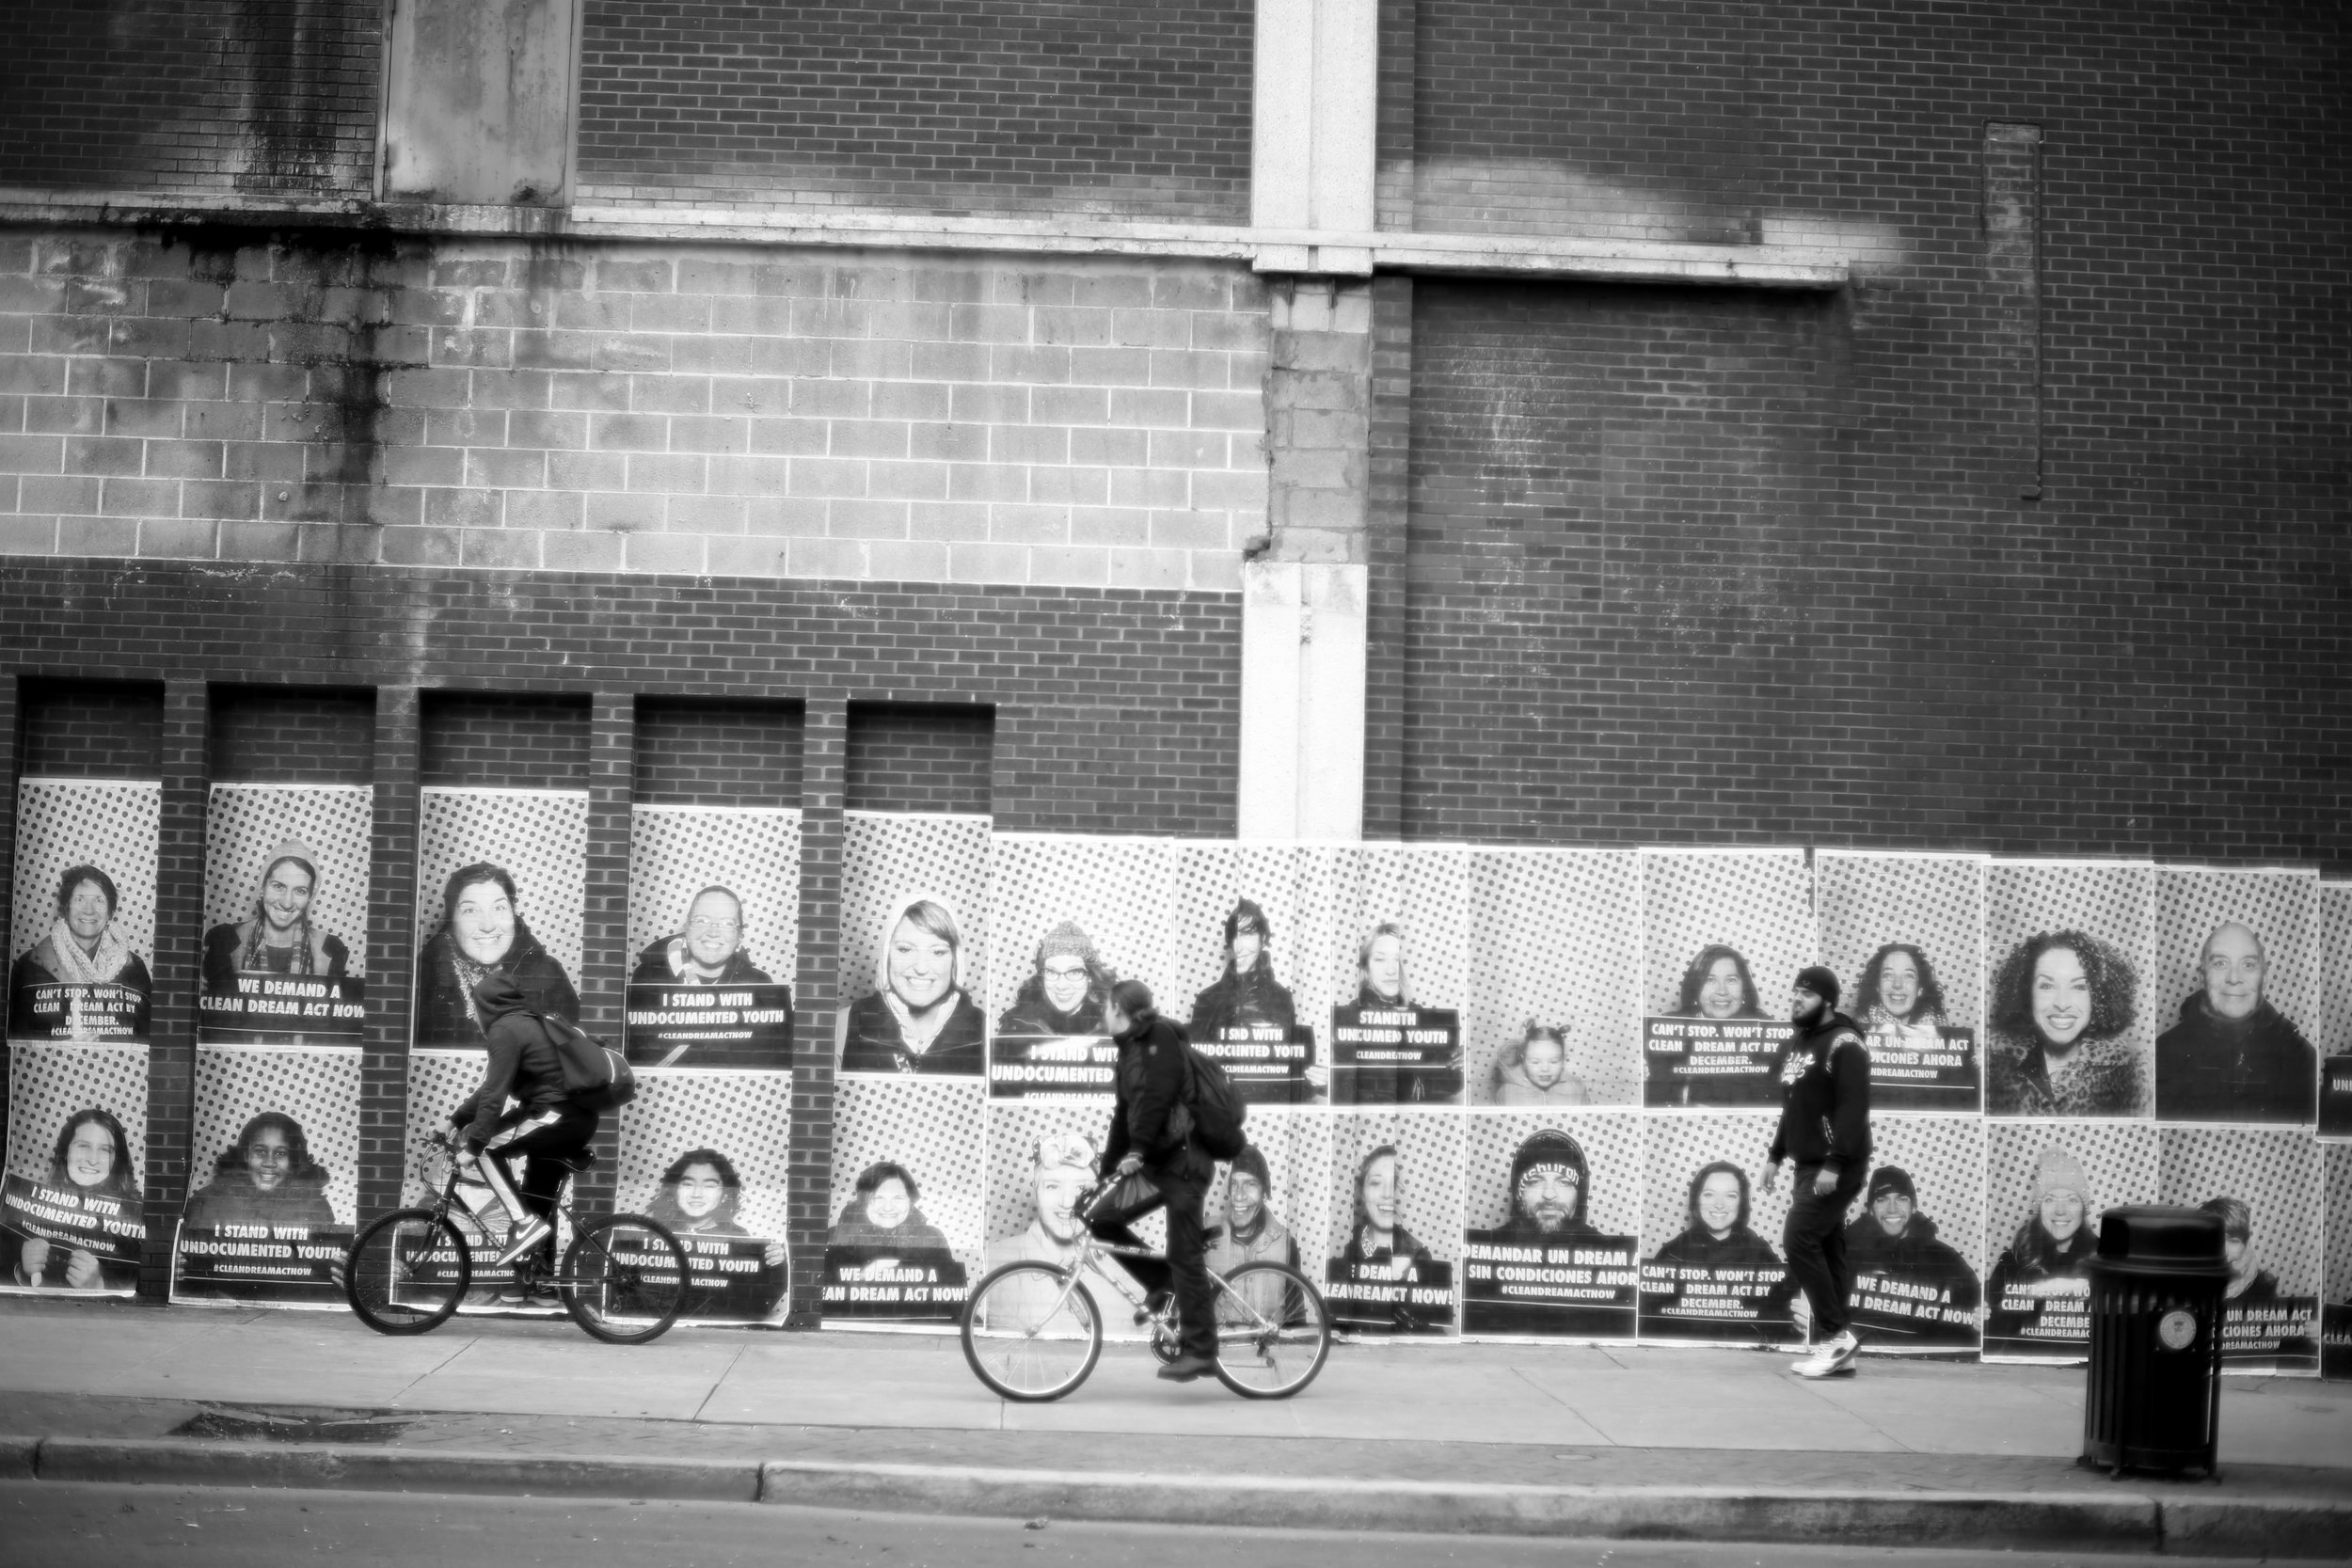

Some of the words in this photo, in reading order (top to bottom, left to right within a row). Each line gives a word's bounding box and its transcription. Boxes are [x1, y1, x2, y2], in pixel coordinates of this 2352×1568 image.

[36, 989, 61, 999] CAN'T
[65, 989, 90, 998] STOP.
[238, 978, 260, 993] WE
[264, 981, 326, 997] DEMAND
[330, 986, 340, 998] A
[199, 996, 243, 1011] CLEAN
[248, 999, 298, 1015] DREAM
[303, 1003, 329, 1016] ACT
[663, 993, 667, 1006] I
[673, 993, 714, 1006] STAND
[720, 993, 753, 1006] WITH
[34, 1003, 59, 1013] CLEAN
[107, 1003, 123, 1011] ACT
[126, 1004, 135, 1013] BY
[66, 1016, 119, 1025] DCEMBER.
[628, 1011, 738, 1024] UNDOCUMENTED
[742, 1010, 784, 1023] YOUTH
[659, 1031, 753, 1039] #CLEANDREAMACTNOW
[1220, 1028, 1225, 1040] I
[1252, 1029, 1282, 1040] WITH
[1406, 1030, 1448, 1043] YOUTH
[1652, 1023, 1684, 1036] CAN'T
[1688, 1026, 1719, 1037] STOP.
[1723, 1026, 1763, 1037] WON'T
[1766, 1028, 1794, 1038] STOP
[1649, 1039, 1682, 1052] CLEAN
[1695, 1041, 1736, 1052] DREAM
[1740, 1042, 1760, 1052] ACT
[1763, 1043, 1779, 1053] BY
[1885, 1037, 1900, 1047] UN
[1949, 1039, 1969, 1051] ACT
[1031, 1046, 1035, 1059] I
[1691, 1056, 1752, 1066] DECEMBER.
[1923, 1054, 1963, 1066] AHORA
[992, 1065, 1114, 1082] UNDOCUMENTED
[31, 1186, 38, 1197] I
[39, 1189, 79, 1207] STAND
[84, 1198, 120, 1215] WITH
[6, 1194, 98, 1228] UNDOCUMENTED
[103, 1219, 146, 1239] YOUTH
[22, 1221, 115, 1252] #CLEANDREAMACTNOW
[215, 1225, 219, 1237] I
[225, 1226, 268, 1239] STAND
[274, 1227, 309, 1240] WITH
[180, 1241, 292, 1258] UNDOCUMENTED
[297, 1246, 341, 1259] YOUTH
[644, 1238, 648, 1249] I
[697, 1242, 729, 1255] WITH
[1463, 1244, 1542, 1262] DEMANDAR
[1548, 1249, 1568, 1263] UN
[1574, 1251, 1627, 1265] DREAM
[214, 1264, 311, 1275] #CLEANDREAMACTNOW
[719, 1259, 759, 1272] YOUTH
[840, 1268, 861, 1281] WE
[865, 1268, 924, 1282] DEMAND
[928, 1269, 937, 1282] A
[1407, 1268, 1418, 1282] A
[1469, 1265, 1491, 1279] SIN
[1497, 1267, 1592, 1284] CONDICIONES
[1643, 1266, 1676, 1278] CAN'T
[1680, 1268, 1711, 1280] STOP.
[1716, 1270, 1755, 1281] WON'T
[1757, 1271, 1786, 1281] STOP
[850, 1288, 899, 1301] DREAM
[904, 1288, 929, 1301] ACT
[933, 1288, 969, 1301] NOW!
[1502, 1286, 1615, 1299] #CLEANDREAMACTNOW
[1640, 1281, 1674, 1293] CLEAN
[1687, 1284, 1727, 1295] DREAM
[1731, 1286, 1752, 1295] ACT
[1756, 1286, 1771, 1296] BY
[1857, 1275, 1877, 1291] WE
[1881, 1280, 1938, 1301] DEMAND
[1942, 1290, 1950, 1304] A
[1412, 1289, 1453, 1305] NOW!
[1681, 1298, 1743, 1309] DECEMBER.
[1661, 1307, 1757, 1318] #CLEANDREAMACTNOW
[1864, 1296, 1912, 1316] DREAM
[1915, 1305, 1940, 1320] ACT
[2002, 1299, 2034, 1310] CLEAN
[2046, 1301, 2084, 1312] DREAM
[2041, 1316, 2090, 1328] DECEMBE
[2227, 1310, 2243, 1321] UN
[2247, 1310, 2287, 1321] DREAM
[2292, 1309, 2312, 1321] ACT
[2265, 1325, 2305, 1336] AHORA
